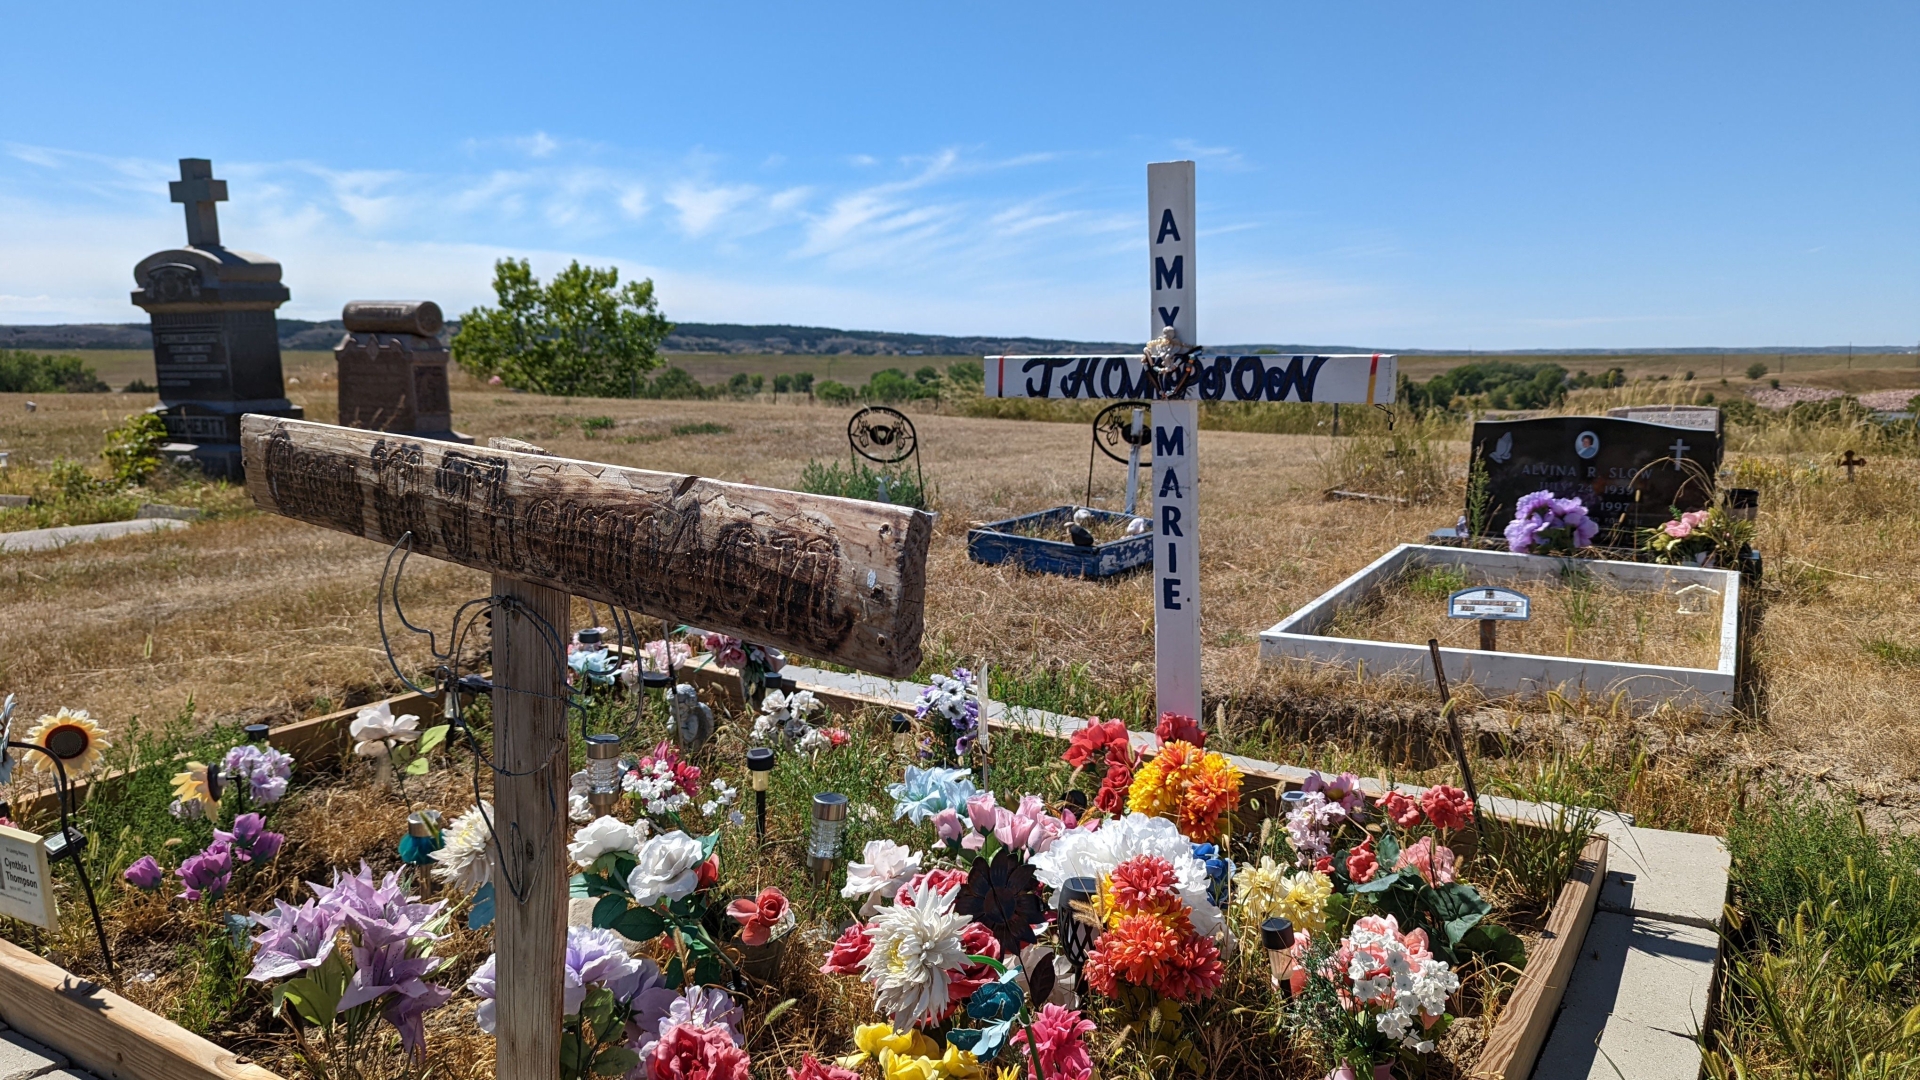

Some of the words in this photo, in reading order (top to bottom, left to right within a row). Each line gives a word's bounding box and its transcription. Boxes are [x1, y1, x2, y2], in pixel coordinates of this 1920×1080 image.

[1155, 208, 1183, 327] AMY
[1521, 464, 1577, 477] ALVINA
[1609, 467, 1653, 479] SLOW
[1604, 485, 1634, 495] 1939
[1600, 501, 1630, 512] 1997
[1156, 425, 1184, 610] MARIE
[4, 857, 27, 872] Cynthia
[5, 870, 38, 888] Thompson
